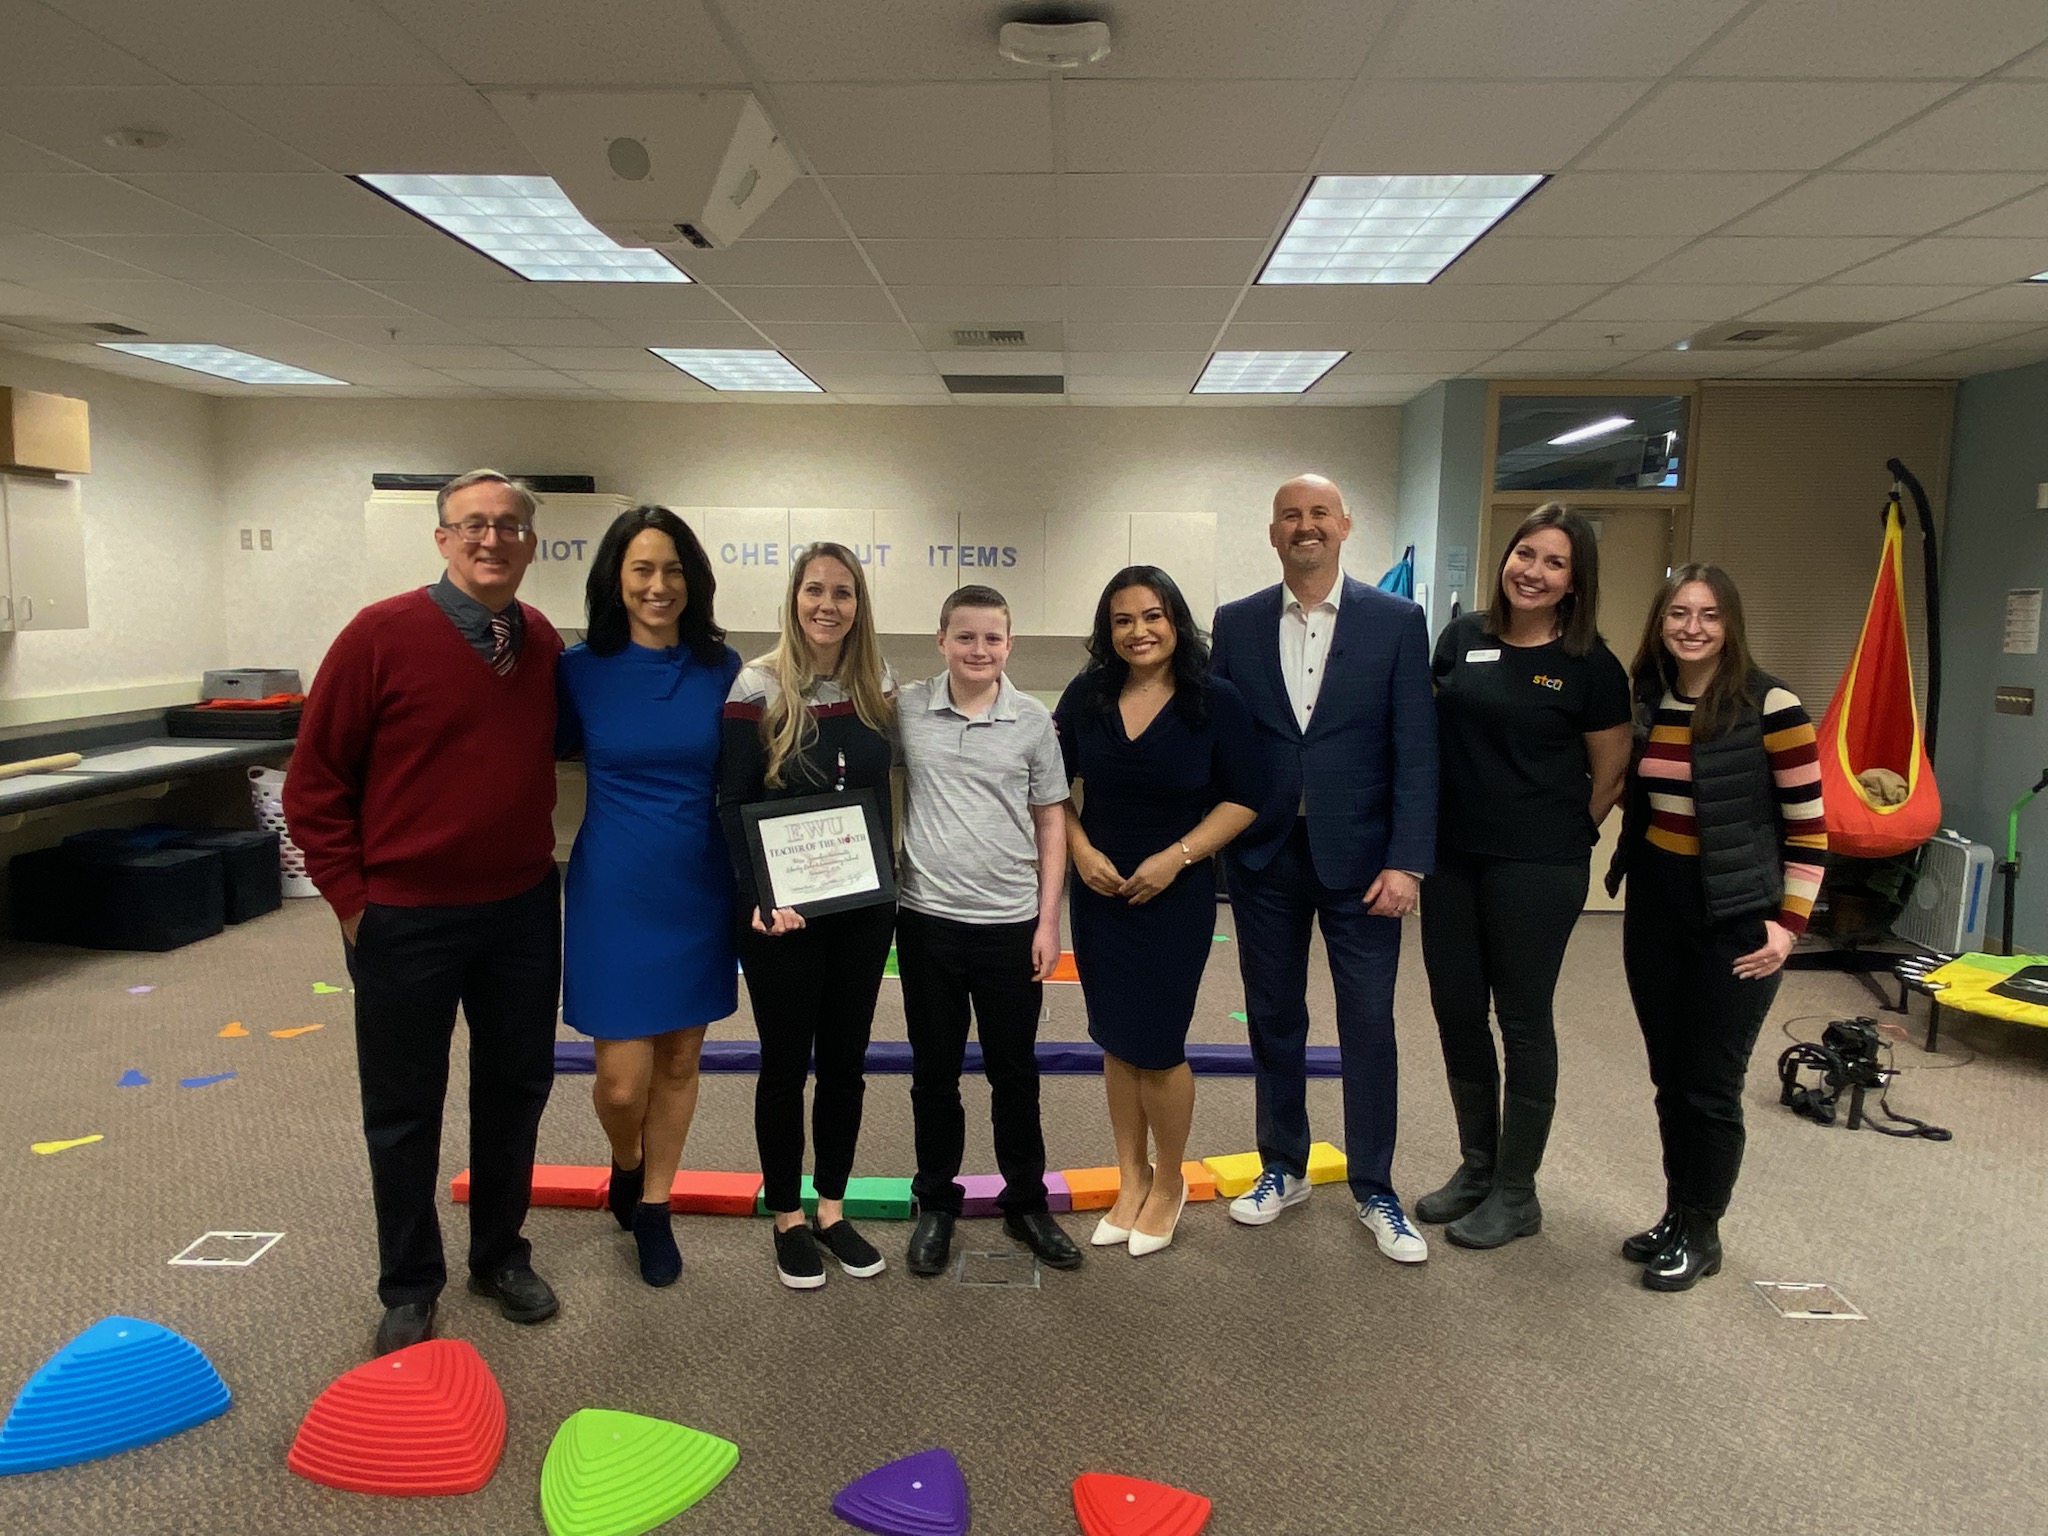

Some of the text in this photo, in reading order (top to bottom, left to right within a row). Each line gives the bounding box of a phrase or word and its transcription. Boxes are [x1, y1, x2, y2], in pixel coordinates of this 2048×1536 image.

[928, 545, 1018, 567] ITEMS
[784, 816, 844, 843] EWU
[769, 845, 806, 858] TEACHER
[805, 841, 817, 852] OF
[819, 839, 835, 850] THE
